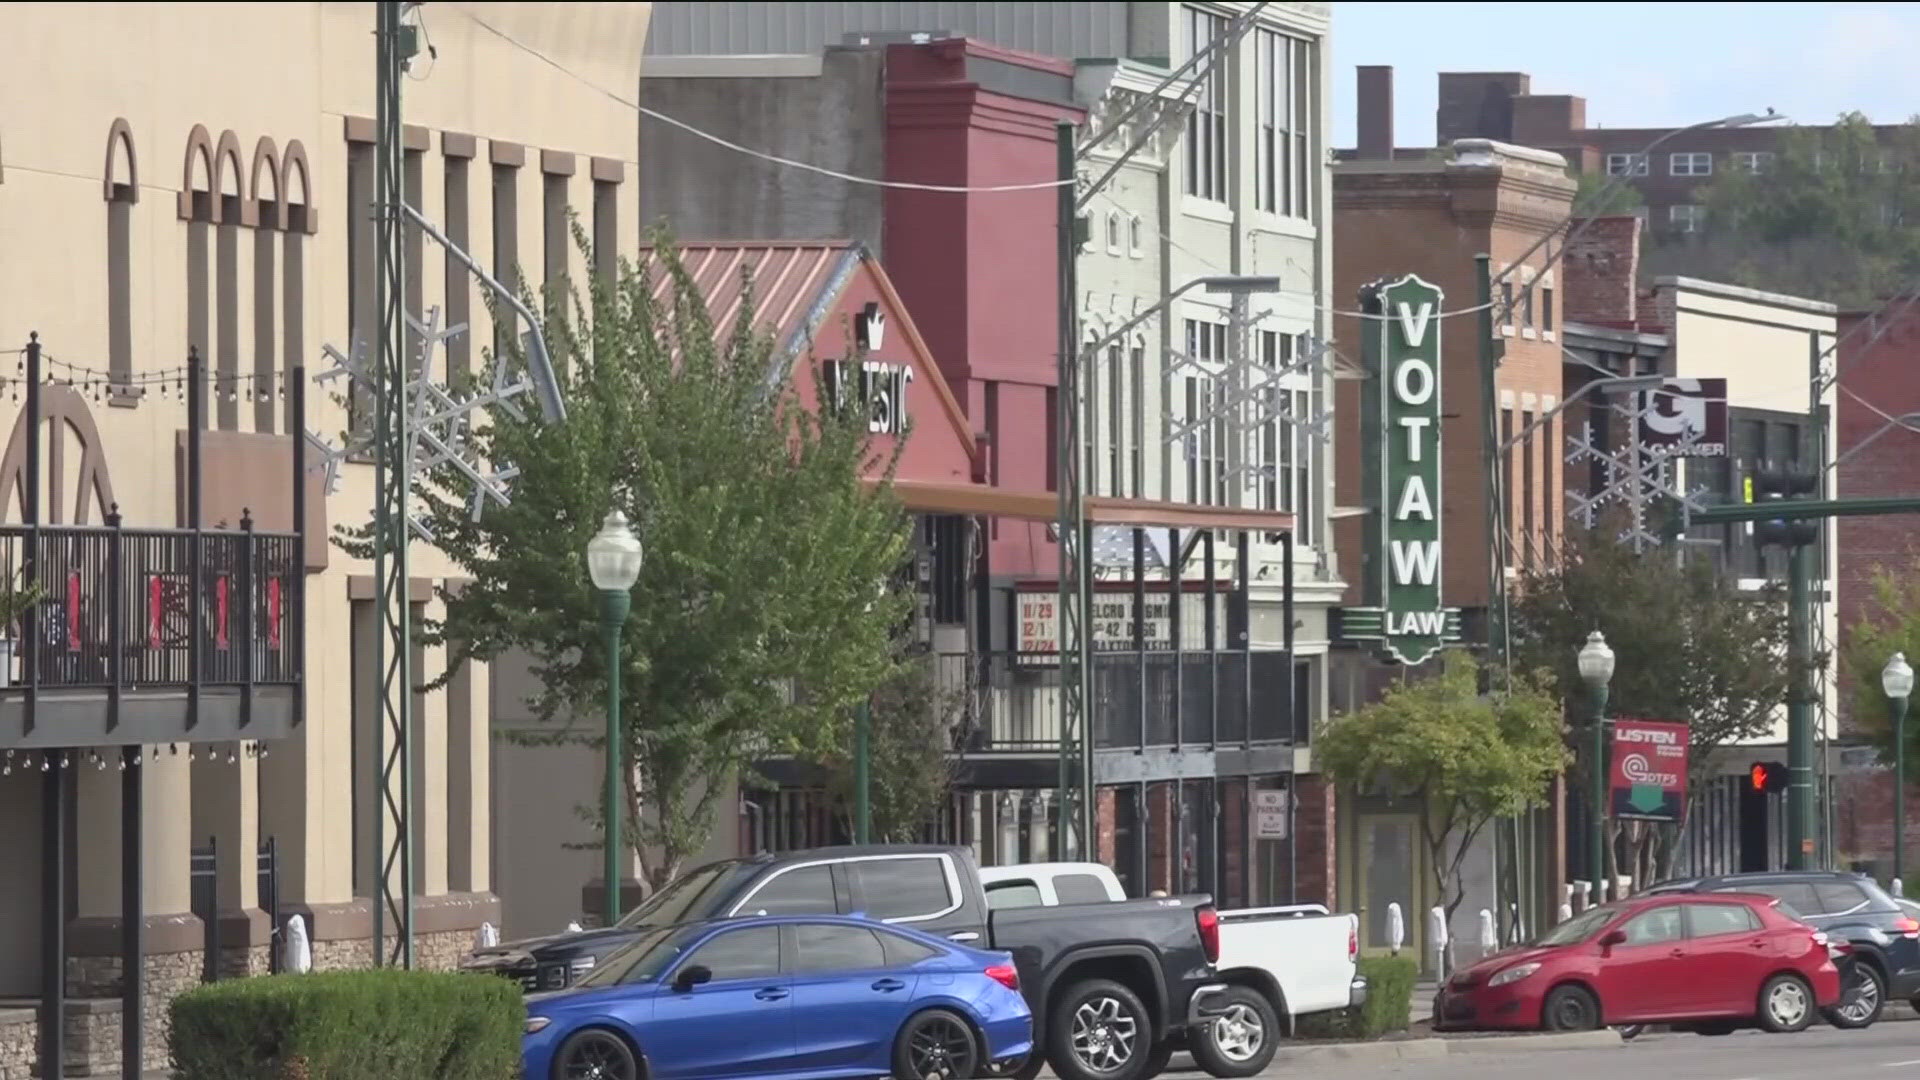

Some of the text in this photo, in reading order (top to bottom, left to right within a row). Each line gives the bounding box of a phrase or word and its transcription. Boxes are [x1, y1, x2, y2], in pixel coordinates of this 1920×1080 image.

[824, 359, 914, 434] MESTIC
[1391, 301, 1440, 586] VOTAW
[1023, 603, 1053, 618] 11/29
[1092, 603, 1125, 618] ELCRO
[1386, 611, 1446, 636] LAW
[1616, 729, 1677, 745] LISTEN
